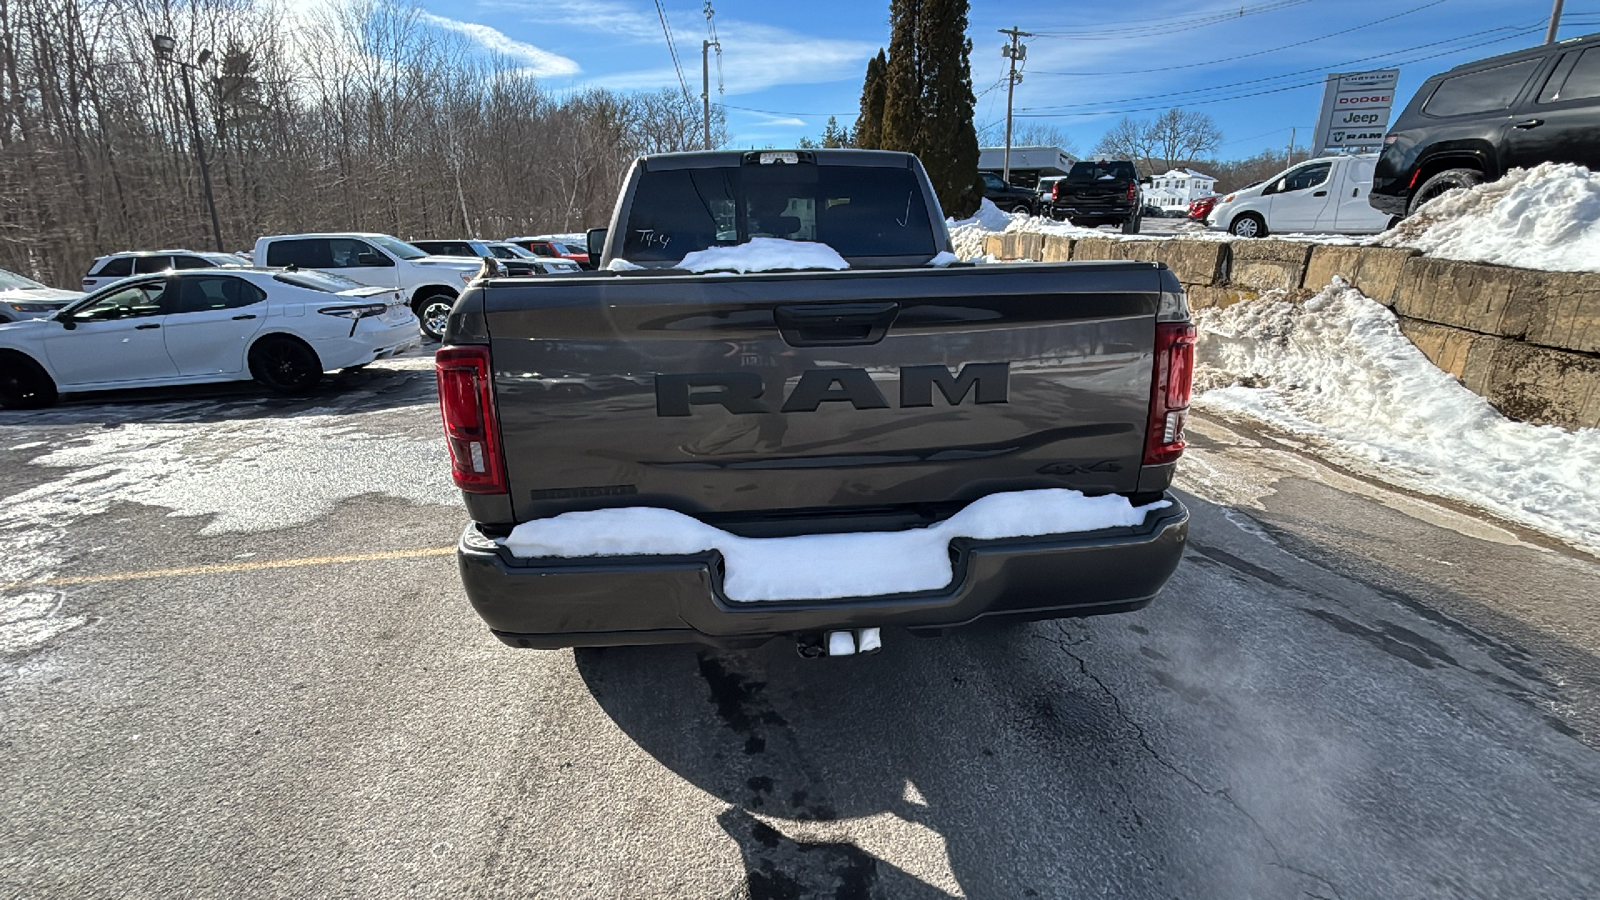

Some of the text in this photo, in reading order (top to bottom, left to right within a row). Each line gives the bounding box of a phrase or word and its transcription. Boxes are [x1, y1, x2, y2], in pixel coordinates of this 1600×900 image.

[1340, 96, 1390, 104] DODGE
[1343, 112, 1379, 124] Jeep
[655, 362, 1011, 417] RAM
